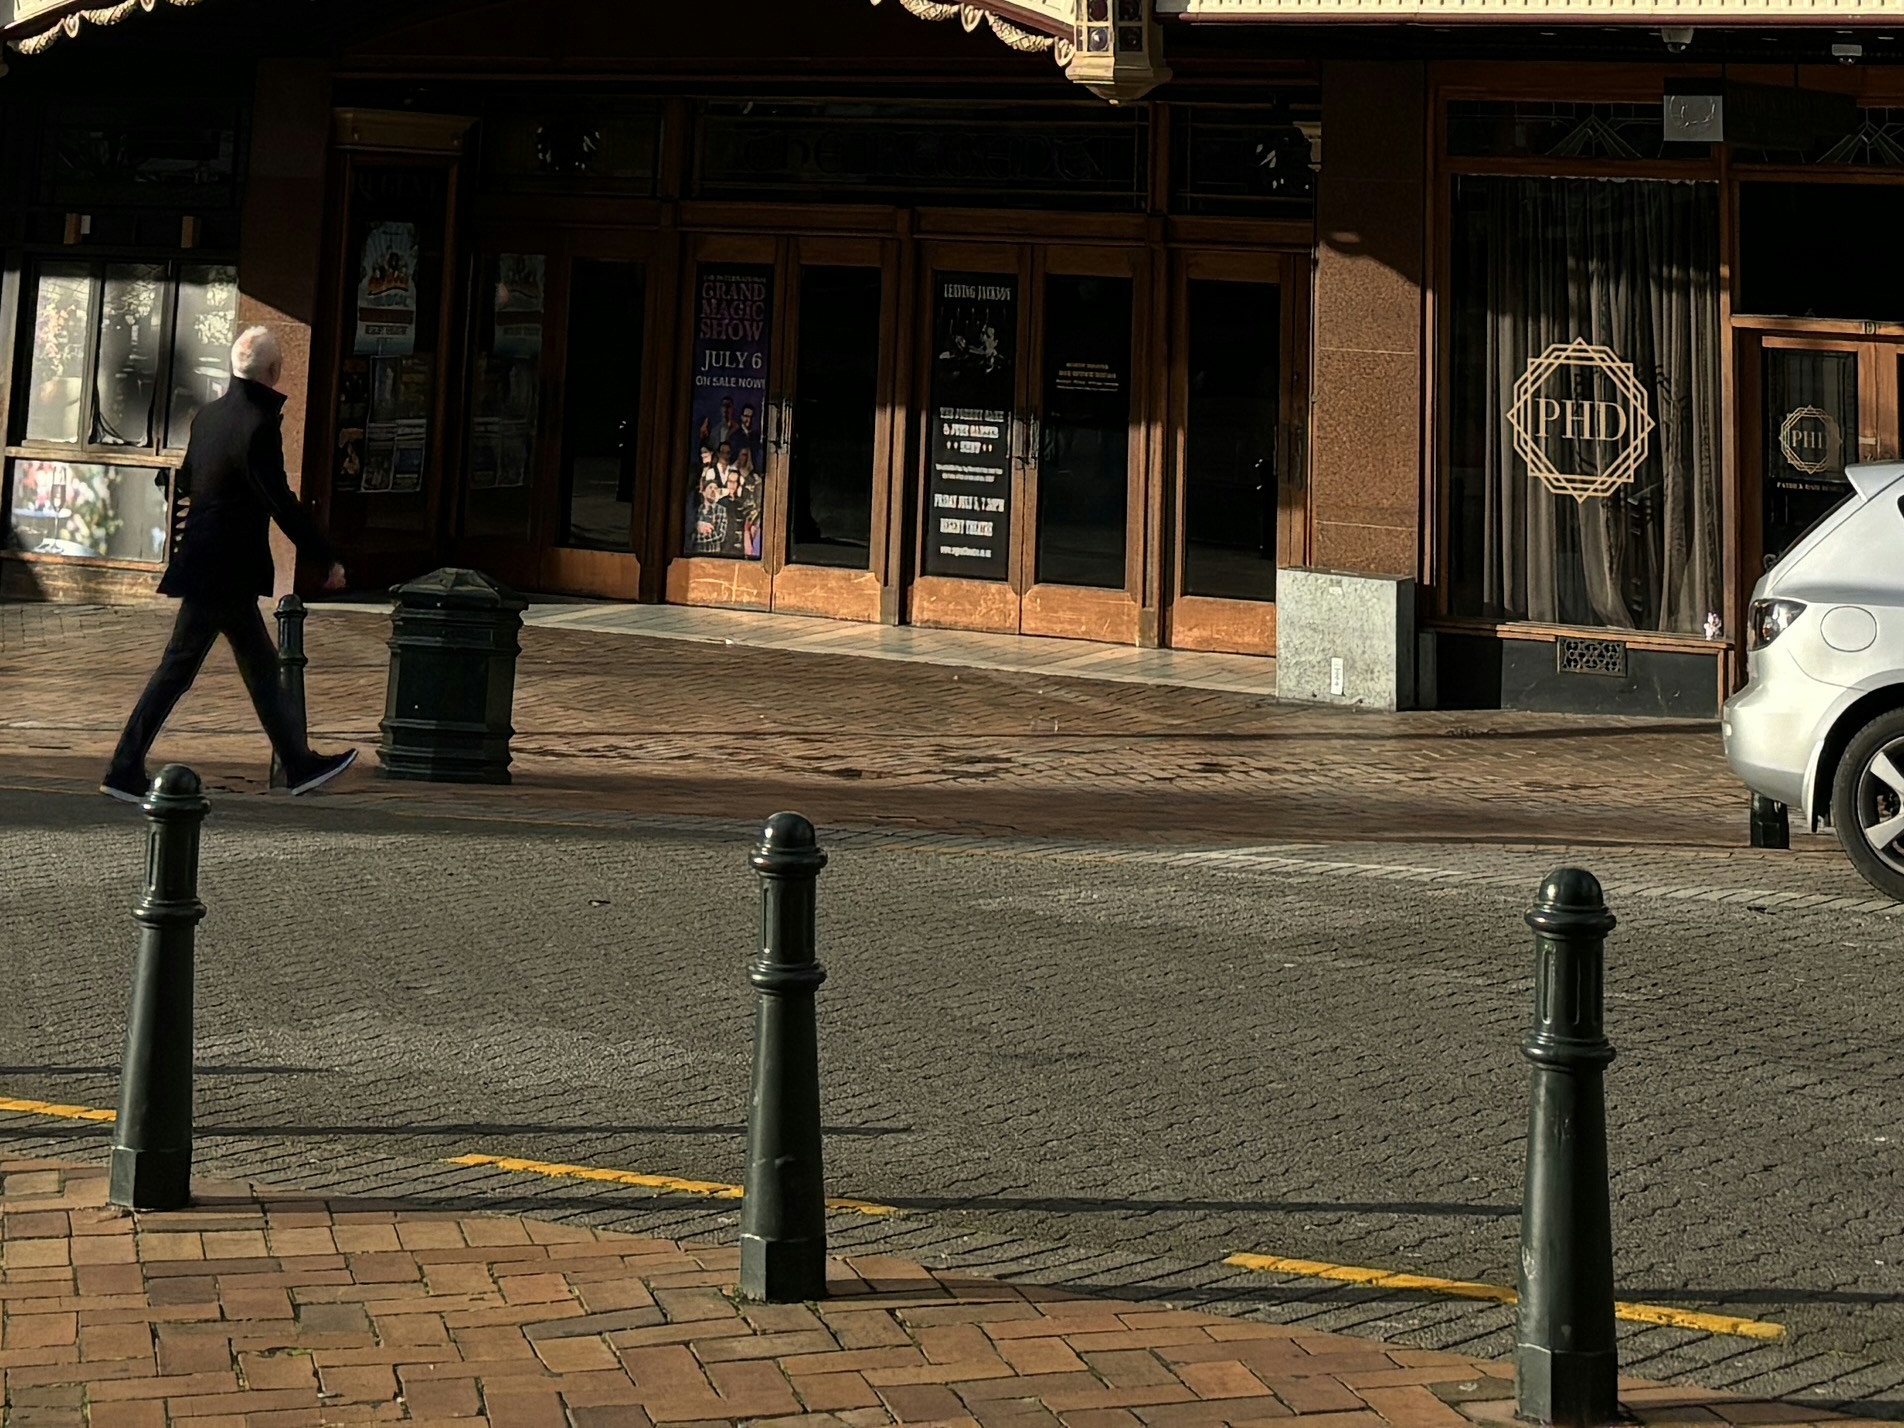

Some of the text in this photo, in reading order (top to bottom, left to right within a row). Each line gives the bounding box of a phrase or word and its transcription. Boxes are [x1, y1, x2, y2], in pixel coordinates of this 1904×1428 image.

[701, 282, 767, 301] GRAND
[699, 299, 766, 320] MAGIC
[699, 319, 765, 342] SHOW
[701, 349, 763, 372] JULY 6
[695, 375, 711, 387] ON
[712, 376, 737, 388] SALE
[1533, 397, 1628, 442] PHD
